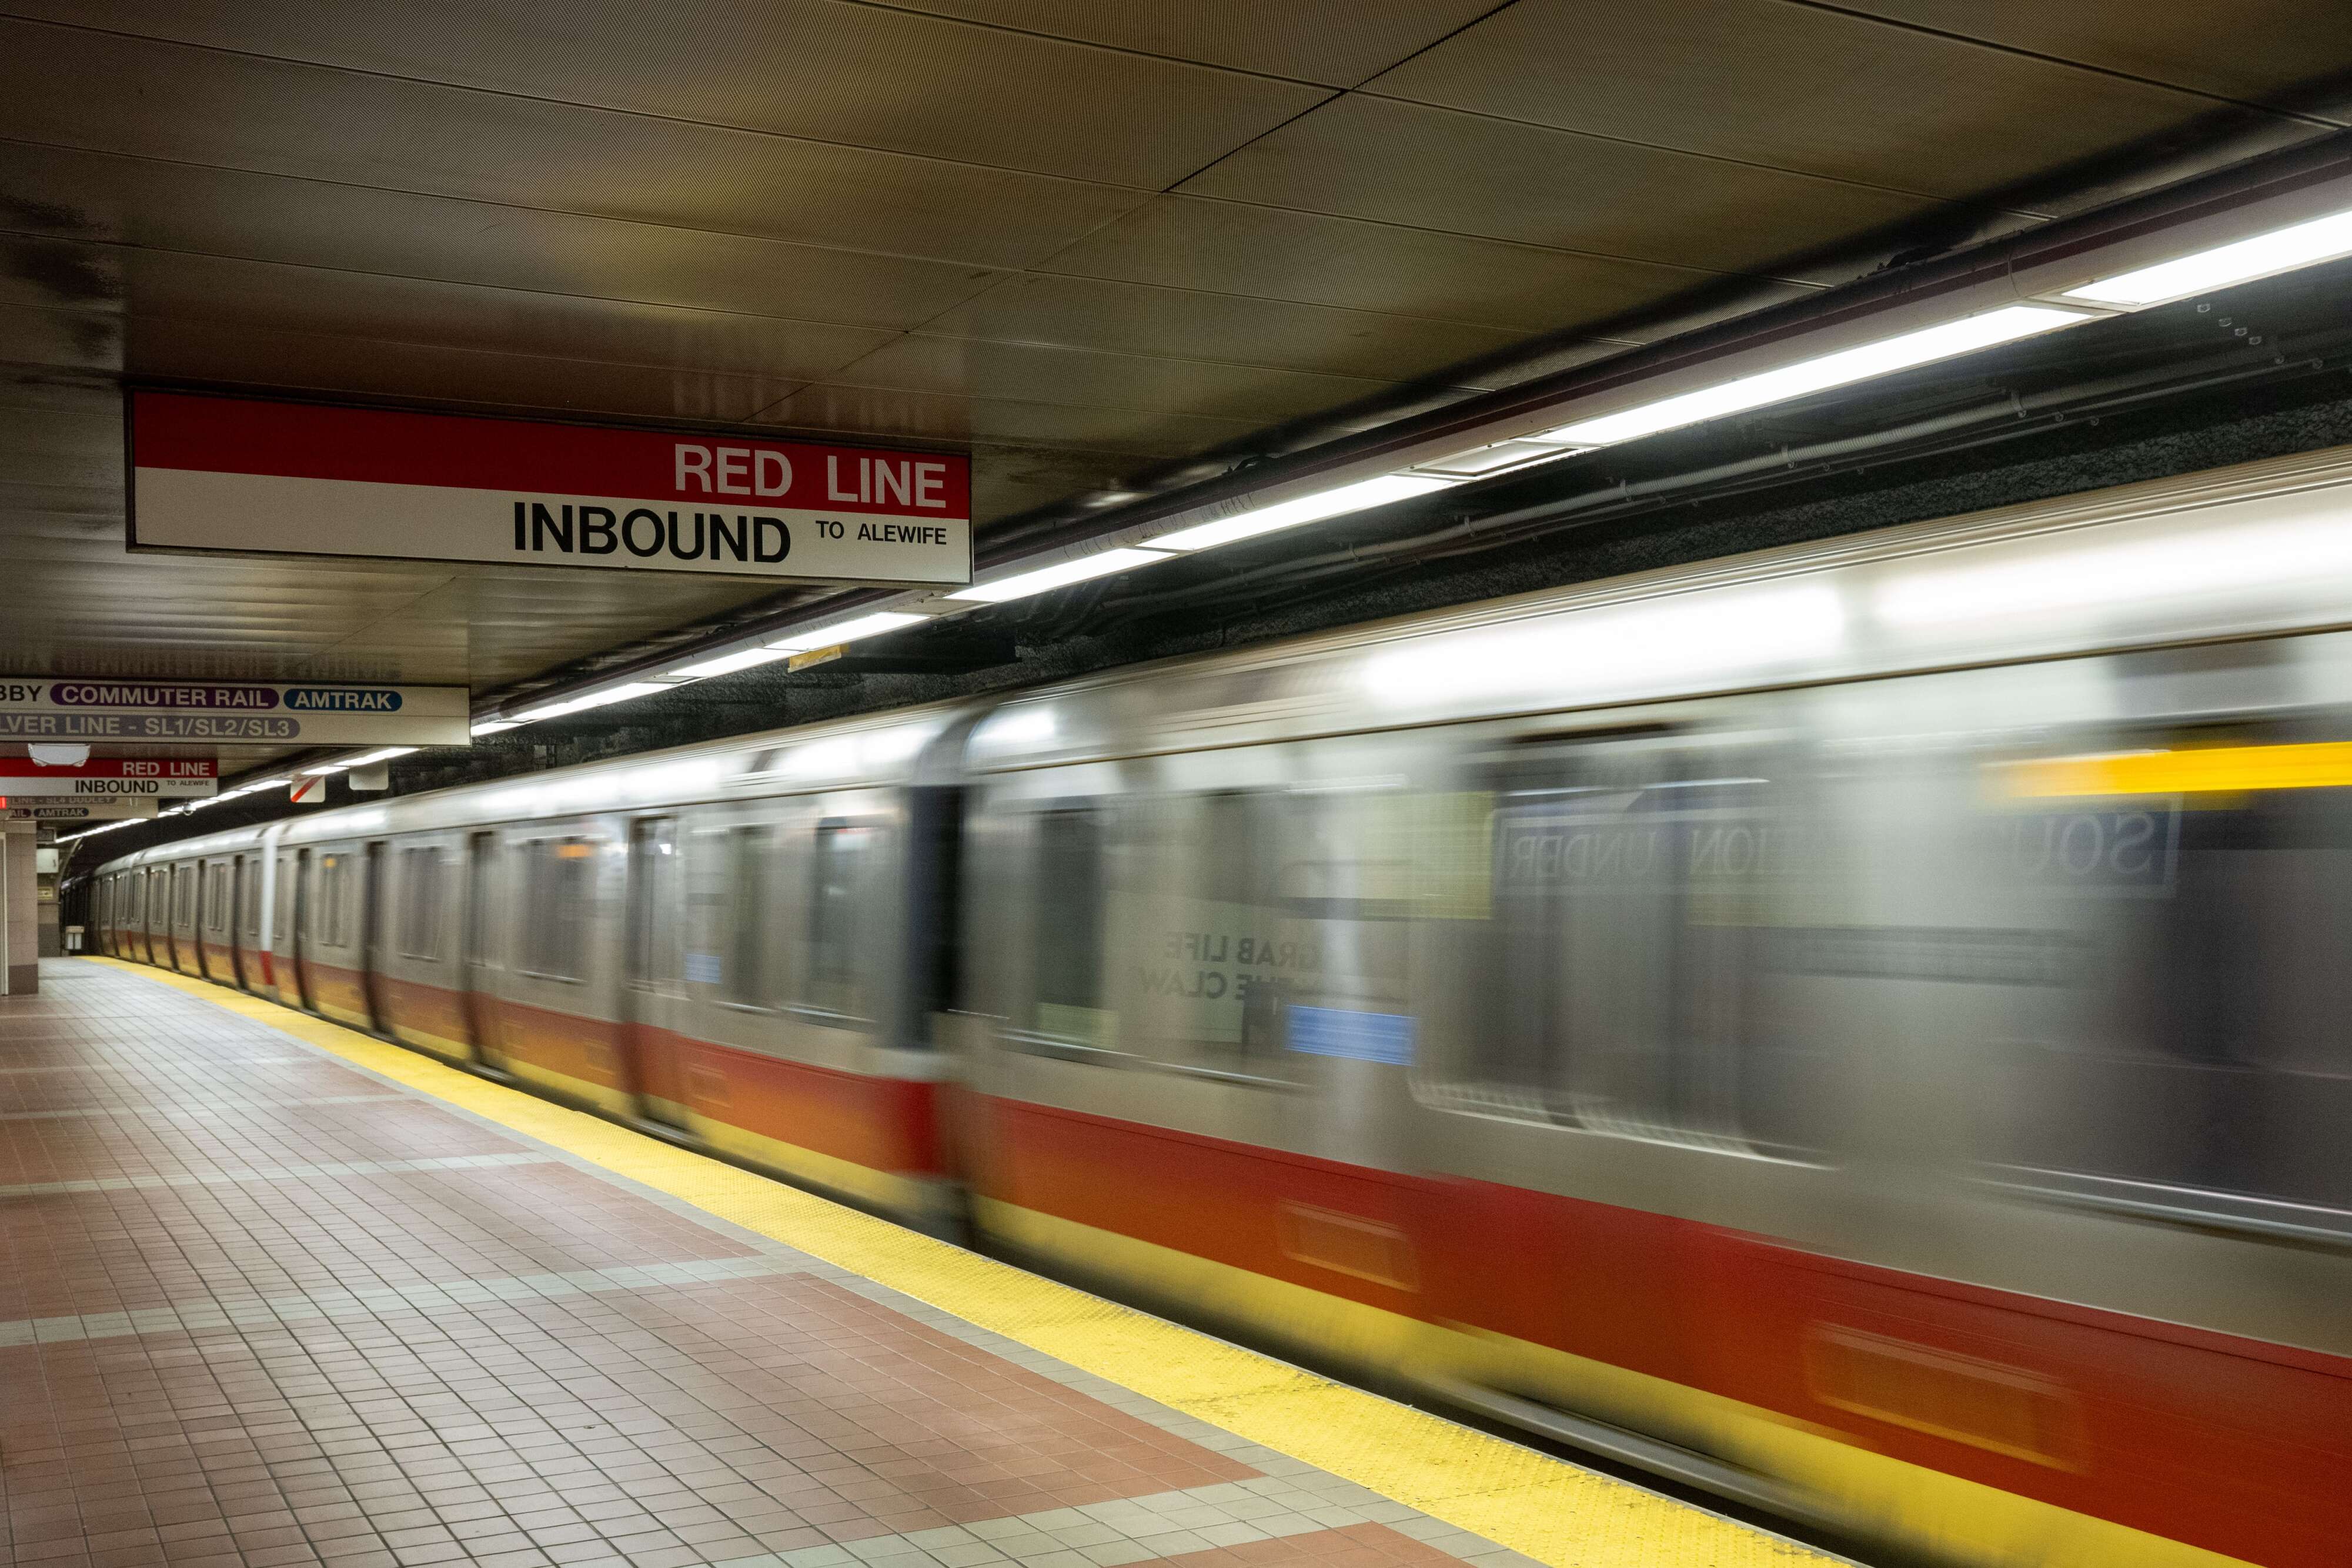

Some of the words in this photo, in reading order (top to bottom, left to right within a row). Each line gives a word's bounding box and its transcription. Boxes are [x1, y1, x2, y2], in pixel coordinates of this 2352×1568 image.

[674, 443, 793, 498] RED
[827, 455, 947, 509] LINE
[514, 502, 791, 563] INBOUND
[816, 520, 845, 540] TO
[857, 523, 947, 545] ALEWIFE
[61, 686, 206, 706] COMMUTER
[215, 689, 269, 707] RAIL
[295, 691, 392, 709] AMTRAK
[65, 716, 121, 734] LINE
[145, 718, 290, 737] SL1/SL2/SL3
[122, 762, 160, 776] RED
[170, 763, 211, 777] LINE
[75, 780, 159, 794] INBOUND
[38, 808, 84, 817] AMTRAK
